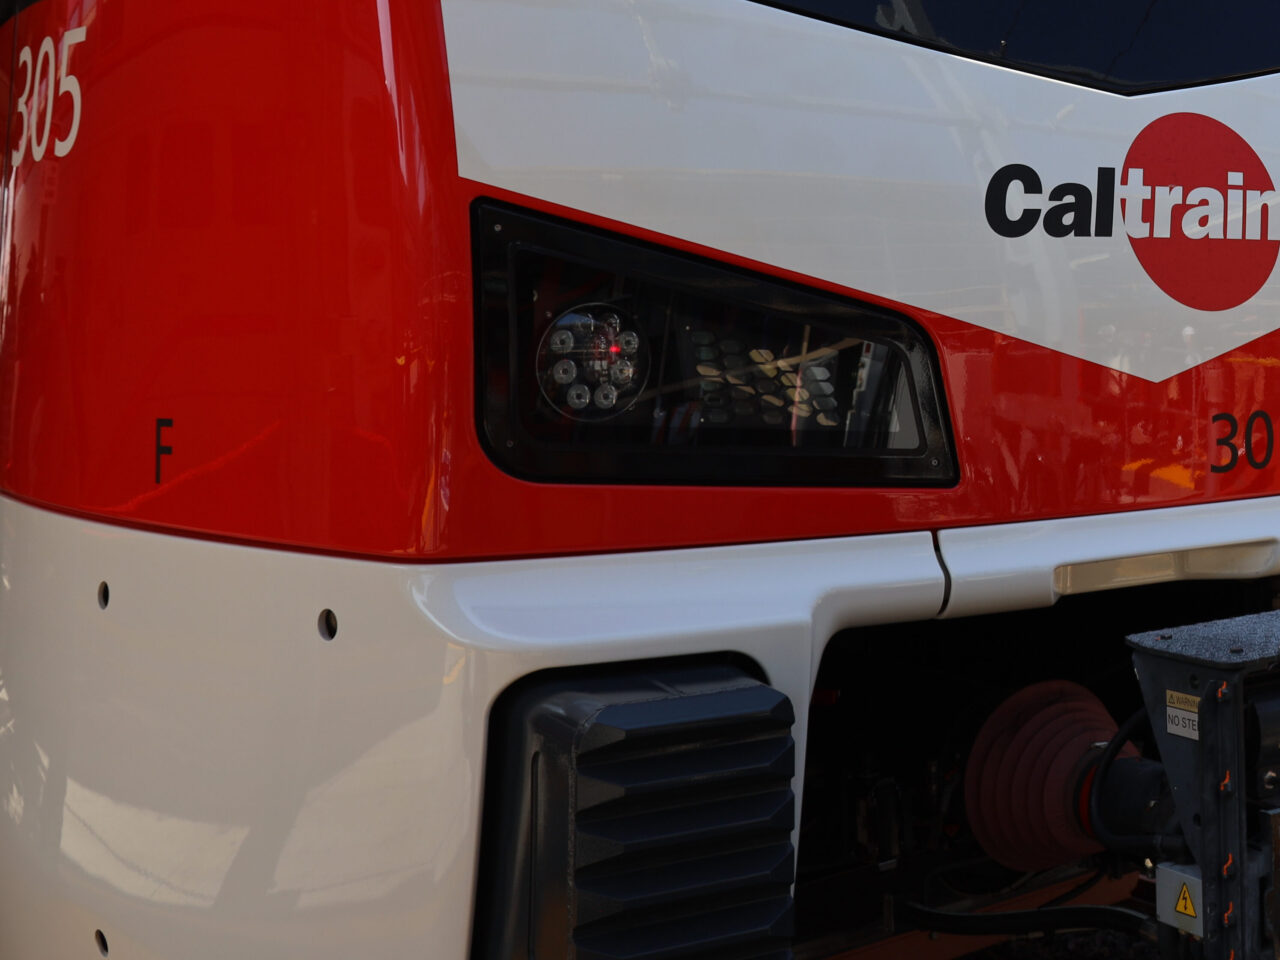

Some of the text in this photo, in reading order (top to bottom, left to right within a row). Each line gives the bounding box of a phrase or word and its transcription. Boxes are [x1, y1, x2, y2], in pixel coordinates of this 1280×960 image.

[11, 26, 87, 168] 305
[984, 163, 1280, 241] Caltrain
[155, 418, 174, 484] F
[1168, 713, 1197, 732] NO STE
